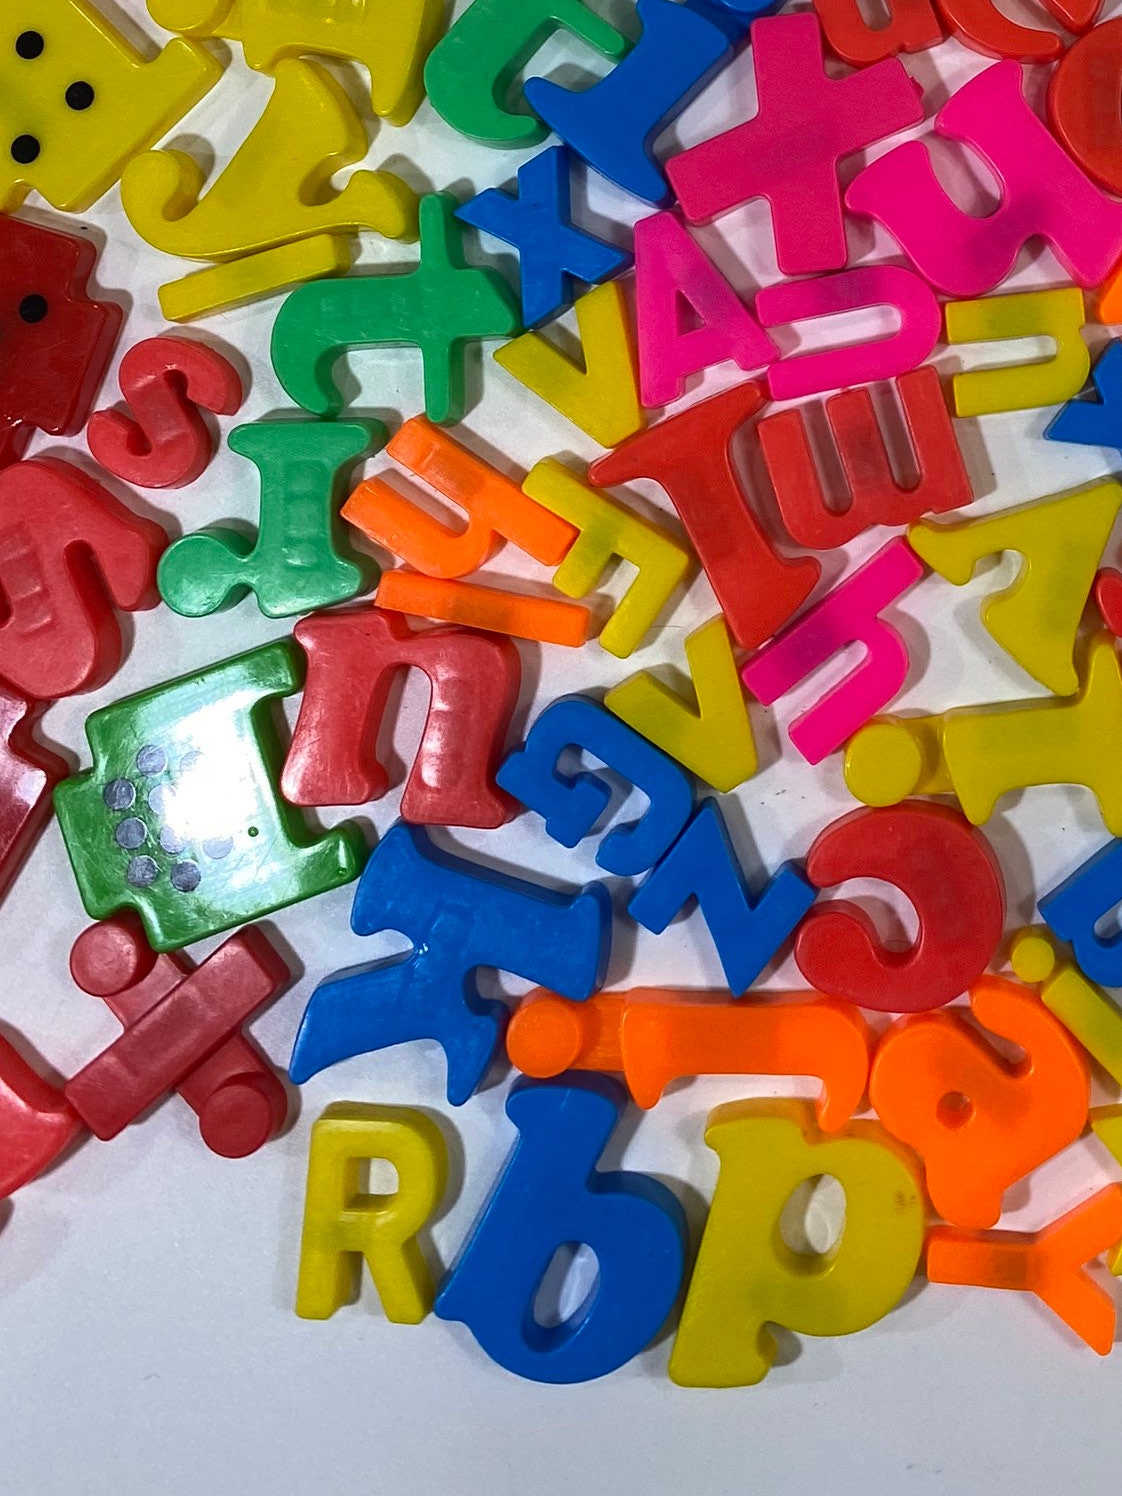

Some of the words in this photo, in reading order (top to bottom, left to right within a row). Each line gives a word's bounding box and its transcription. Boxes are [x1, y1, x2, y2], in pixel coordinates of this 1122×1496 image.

[118, 55, 425, 264] y
[86, 336, 244, 489] s
[632, 208, 783, 411] A
[278, 605, 522, 831] n
[793, 801, 1007, 1016] c
[294, 1100, 452, 1326] R
[433, 1067, 690, 1386] b
[667, 1098, 927, 1391] p
